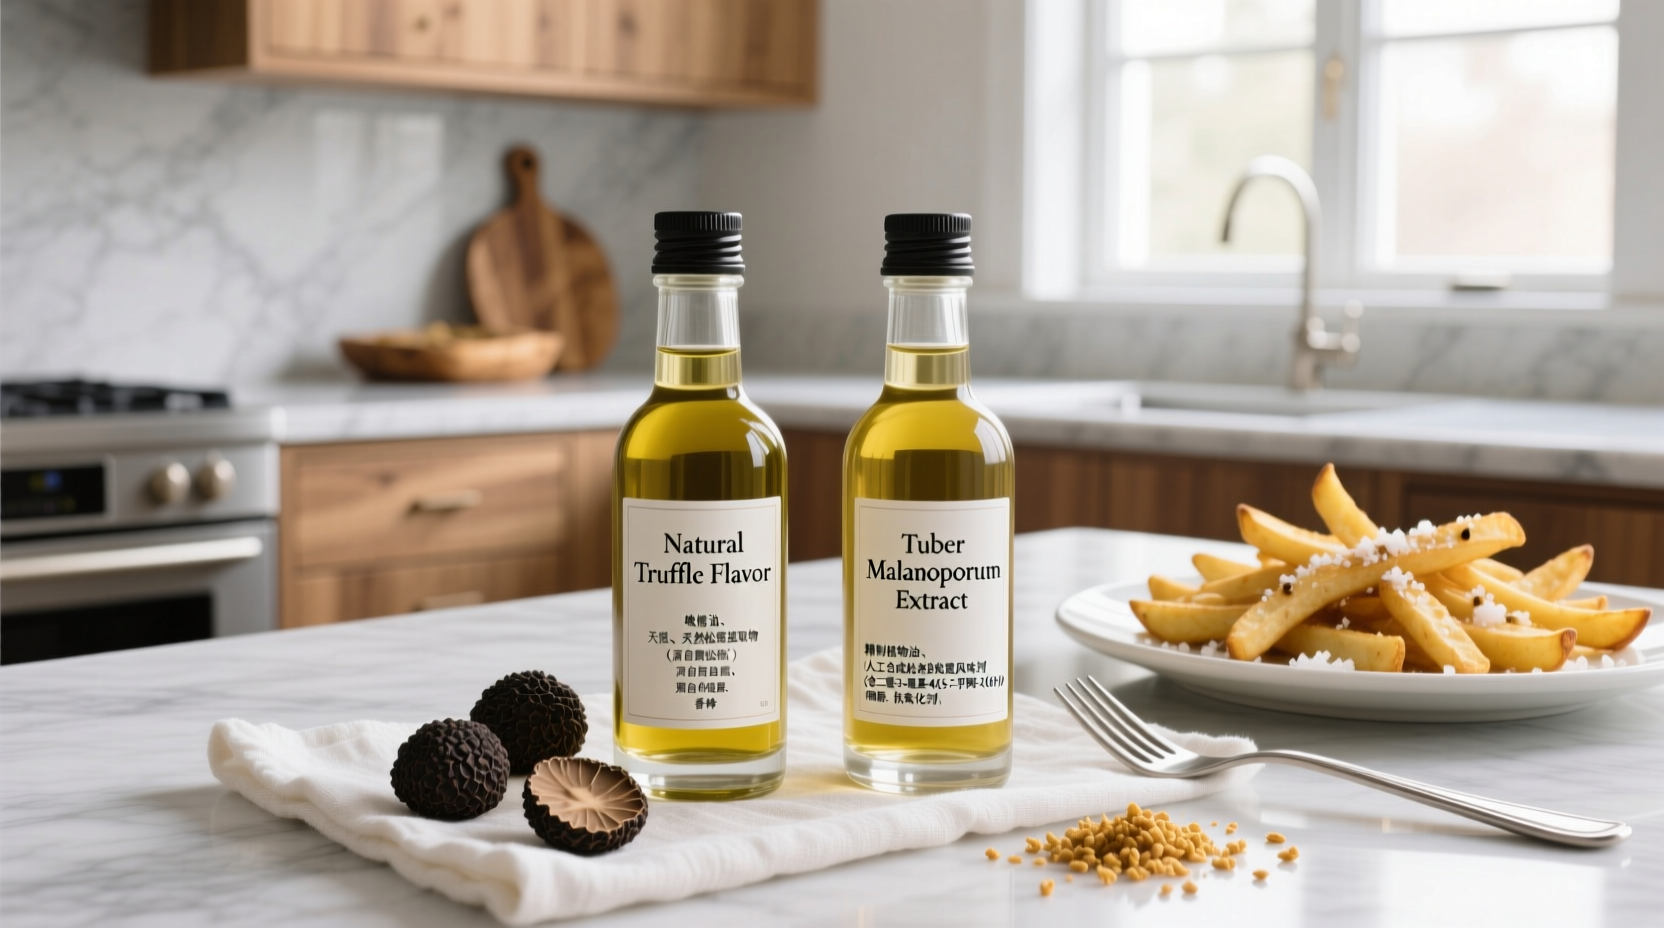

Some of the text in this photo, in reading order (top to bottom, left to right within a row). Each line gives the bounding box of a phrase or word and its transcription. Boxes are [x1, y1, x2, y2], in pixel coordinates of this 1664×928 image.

[664, 530, 744, 554] Natural
[901, 532, 965, 554] Tuber
[634, 561, 771, 584] Truffle Flavor
[866, 558, 1001, 588] Malanoporum
[896, 589, 968, 610] Extract
